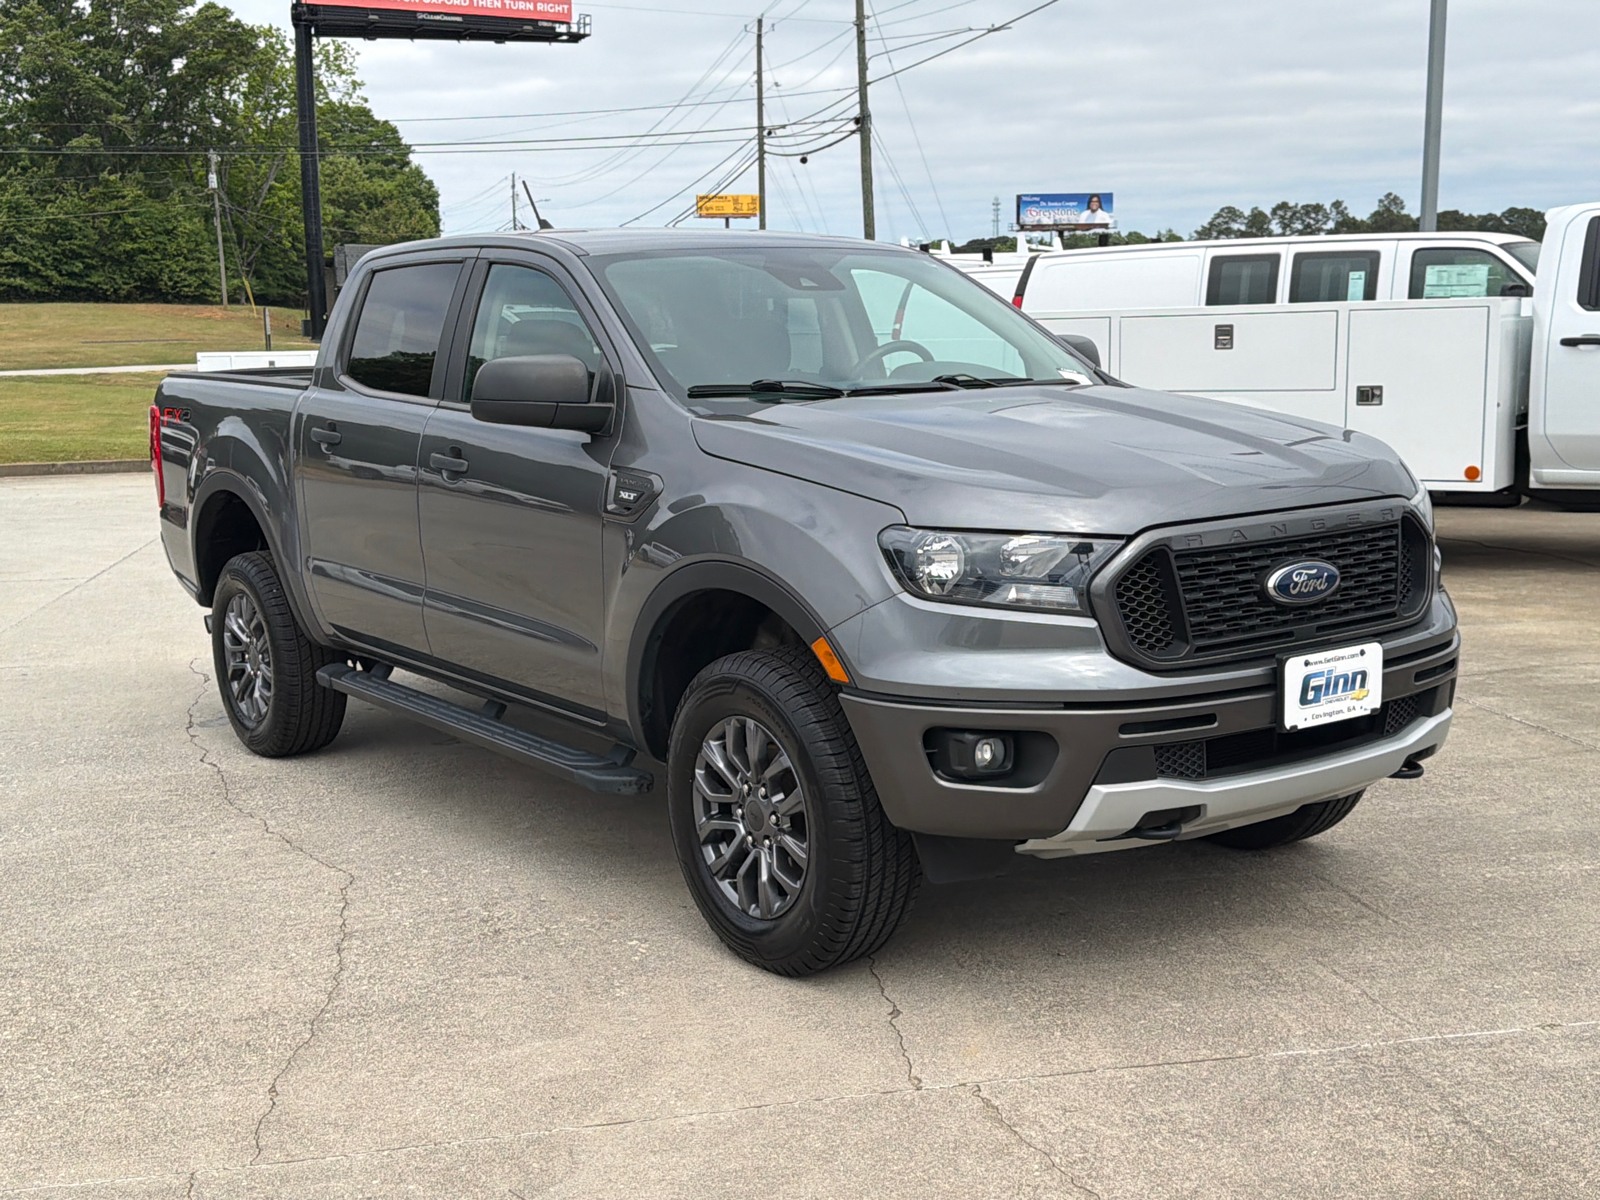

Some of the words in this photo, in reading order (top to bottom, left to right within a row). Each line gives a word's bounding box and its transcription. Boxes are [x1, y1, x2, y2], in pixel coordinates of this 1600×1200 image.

[472, 0, 502, 8] THEN
[504, 0, 533, 11] TURN
[537, 3, 569, 13] RIGHT
[1026, 204, 1078, 219] Greystone
[163, 408, 191, 426] FX2
[619, 490, 637, 500] XLT
[1184, 507, 1396, 547] RANGER
[1289, 568, 1328, 595] Ford
[1308, 653, 1359, 667] www.GetGinn.com
[1299, 669, 1367, 706] Ginn
[1324, 696, 1349, 705] CHEVROLET
[1311, 708, 1345, 720] Covington,
[1347, 705, 1356, 713] GA
